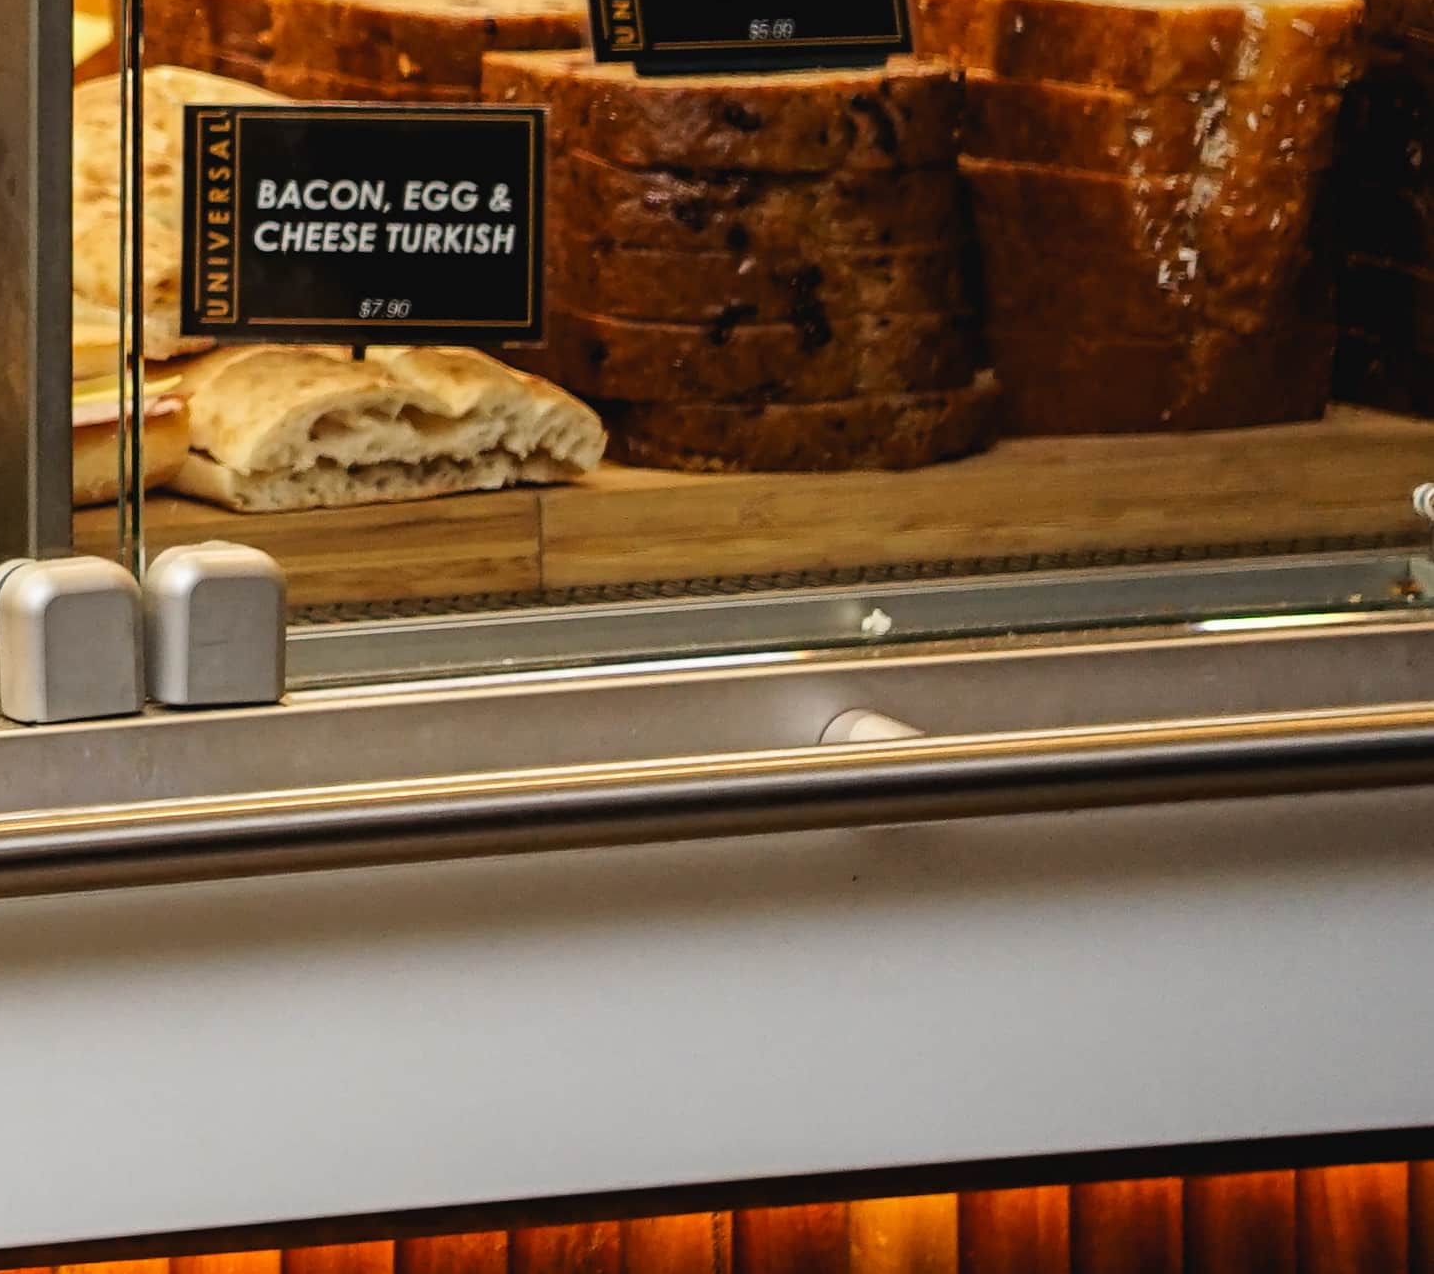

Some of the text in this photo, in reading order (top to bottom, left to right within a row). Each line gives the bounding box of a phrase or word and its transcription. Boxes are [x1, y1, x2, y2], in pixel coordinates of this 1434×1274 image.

[256, 179, 513, 213] BACON, EGG &
[205, 116, 233, 318] UNIVERSAL
[253, 220, 517, 255] CHEESE TURKISH
[358, 298, 412, 319] $7.90
